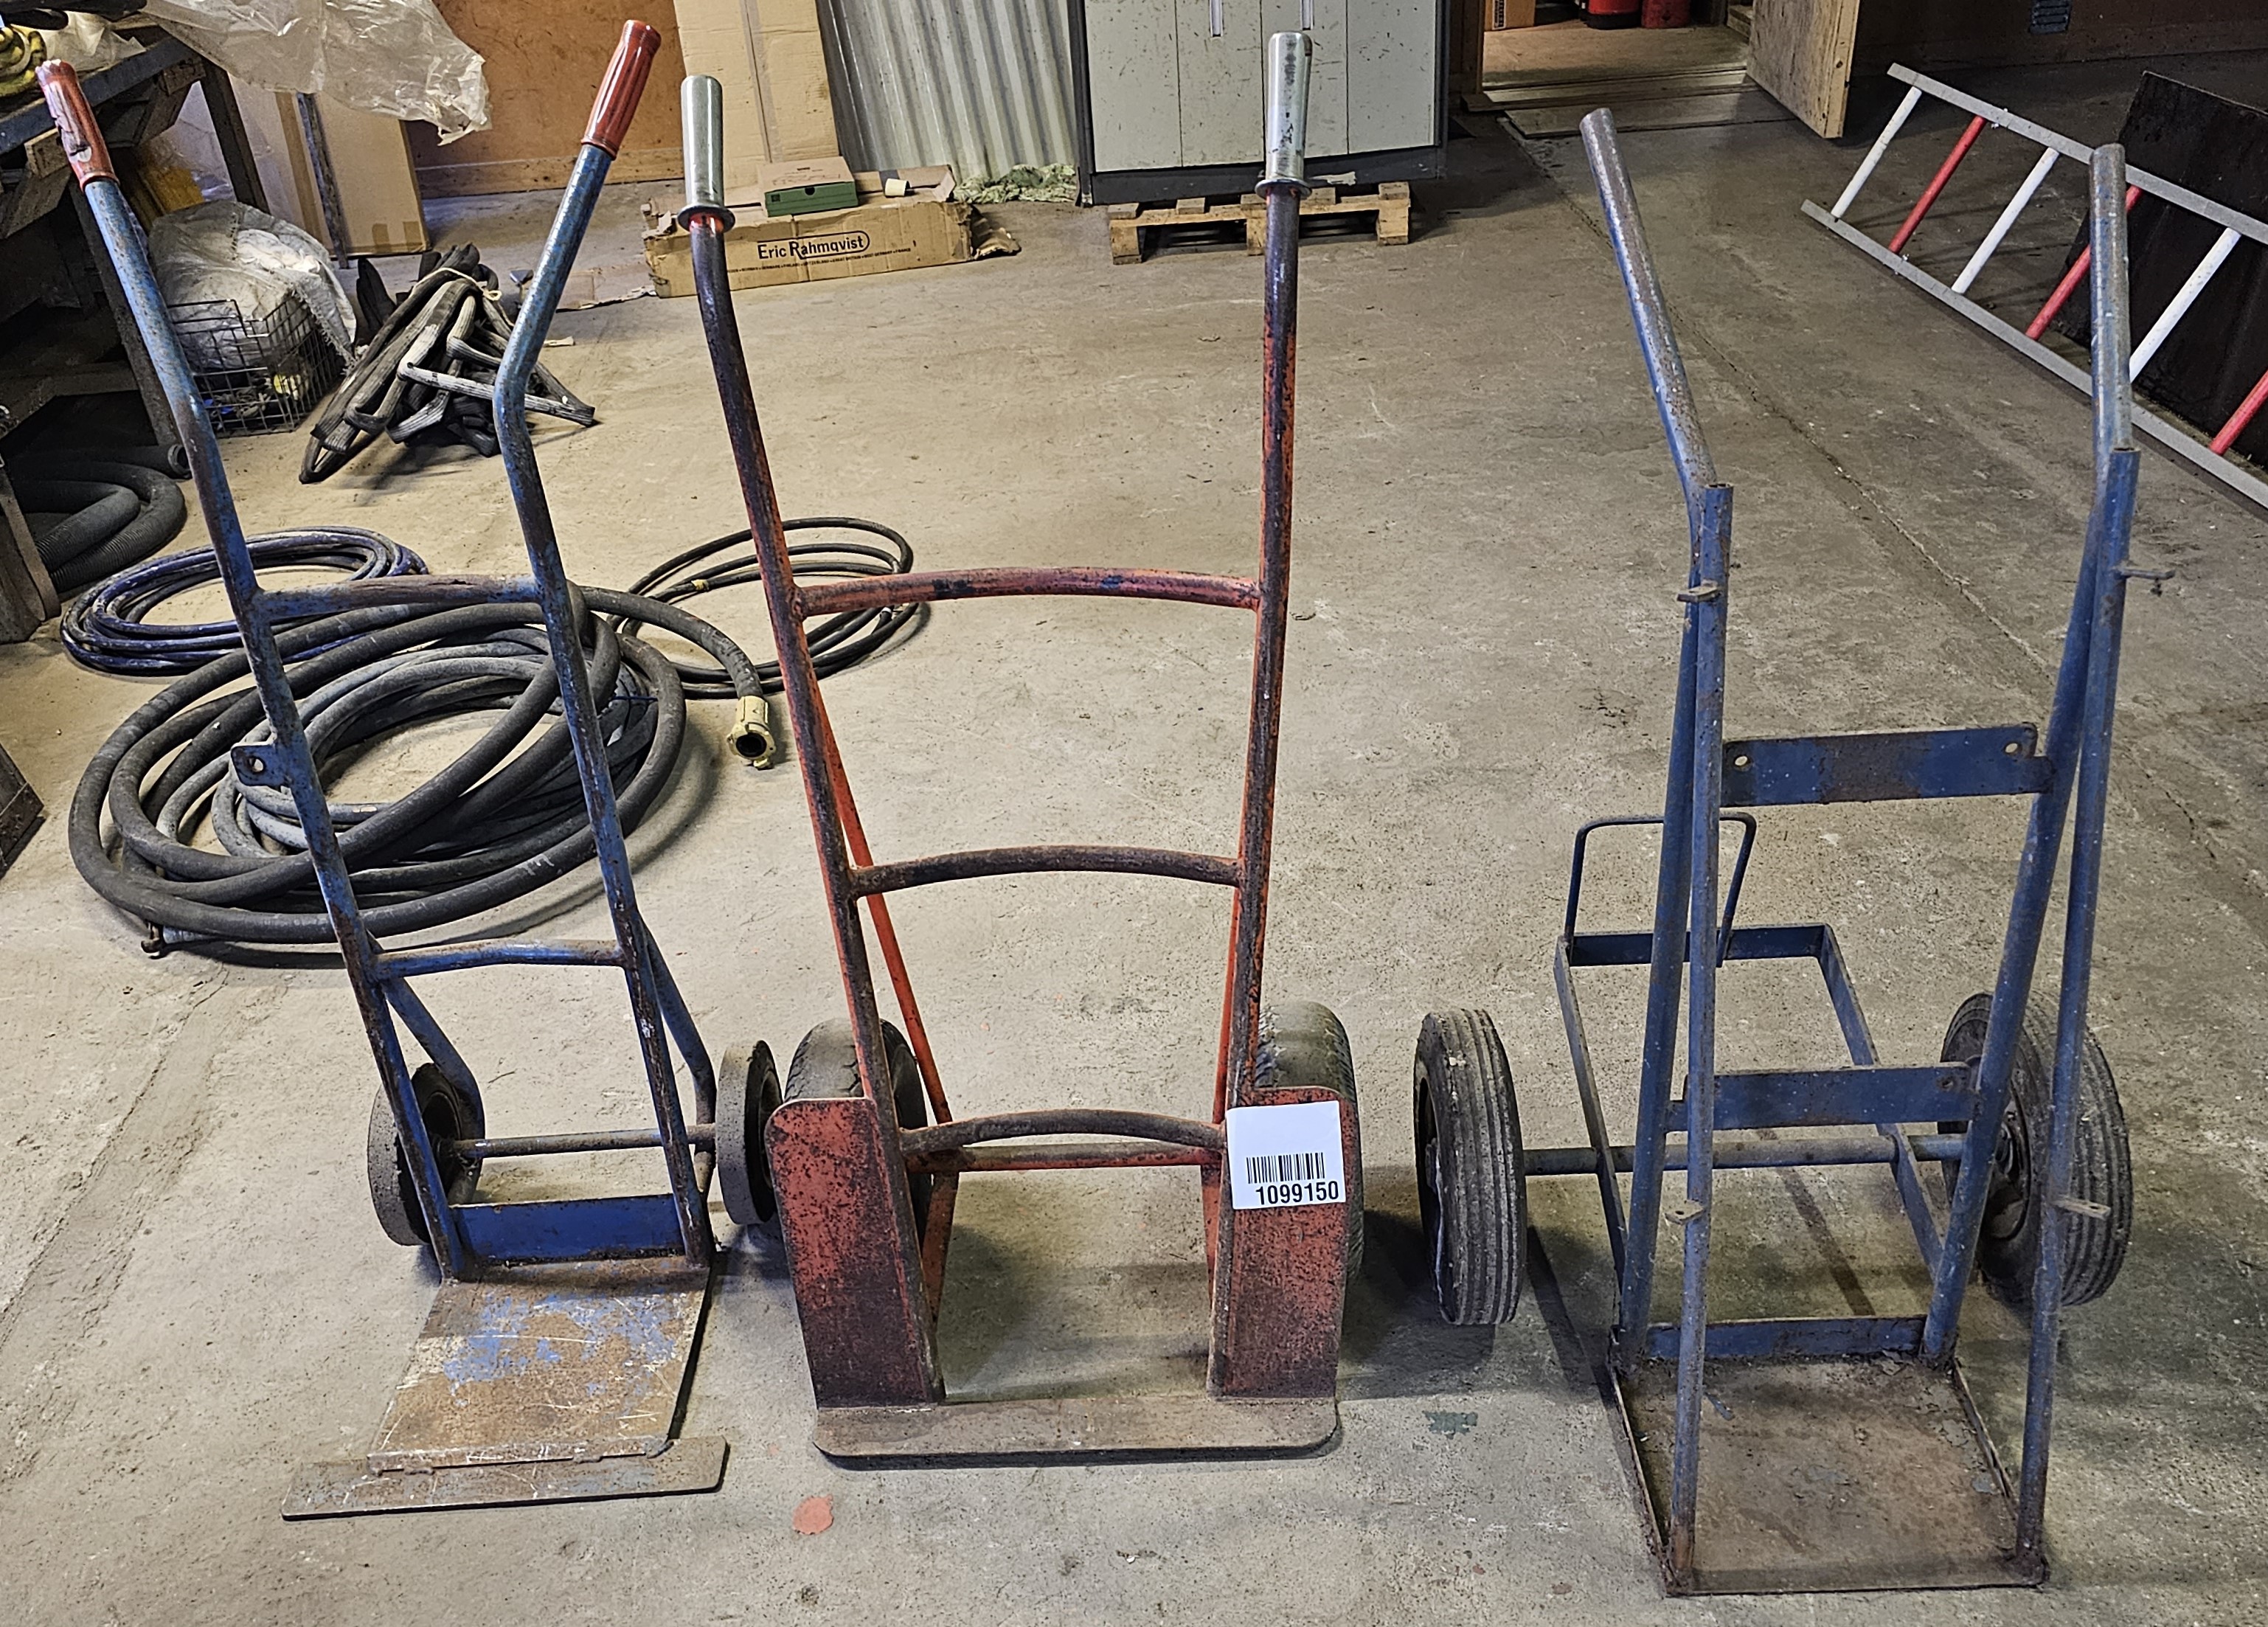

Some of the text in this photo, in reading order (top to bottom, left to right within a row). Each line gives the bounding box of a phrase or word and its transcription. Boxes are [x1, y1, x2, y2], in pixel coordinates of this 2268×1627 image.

[757, 236, 864, 260] Eric Rahmqvist
[1255, 1181, 1339, 1205] 1099150
